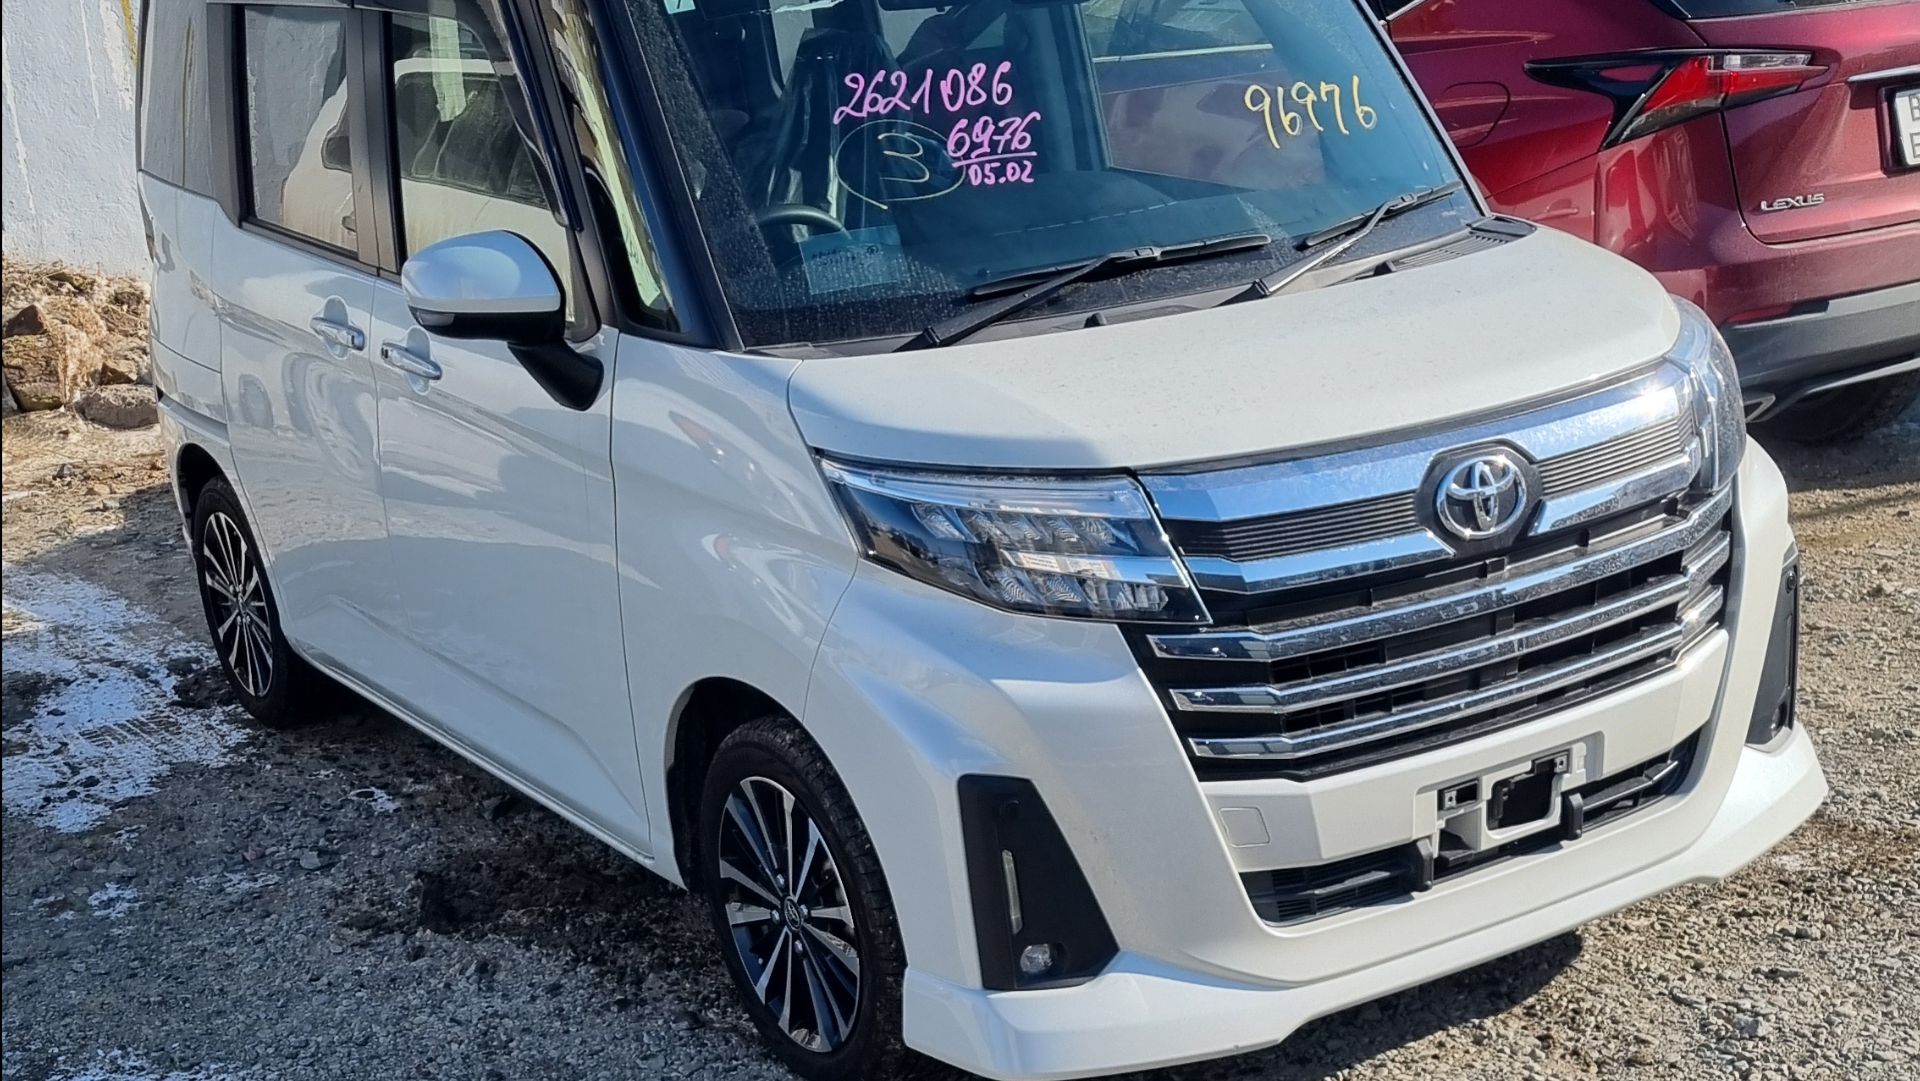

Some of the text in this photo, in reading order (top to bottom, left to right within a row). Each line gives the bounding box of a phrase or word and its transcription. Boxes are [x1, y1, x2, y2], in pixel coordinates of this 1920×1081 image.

[1245, 75, 1378, 149] 96976
[947, 111, 1041, 159] 6976
[968, 160, 1034, 186] 05.02
[1760, 193, 1825, 211] LEXUS
